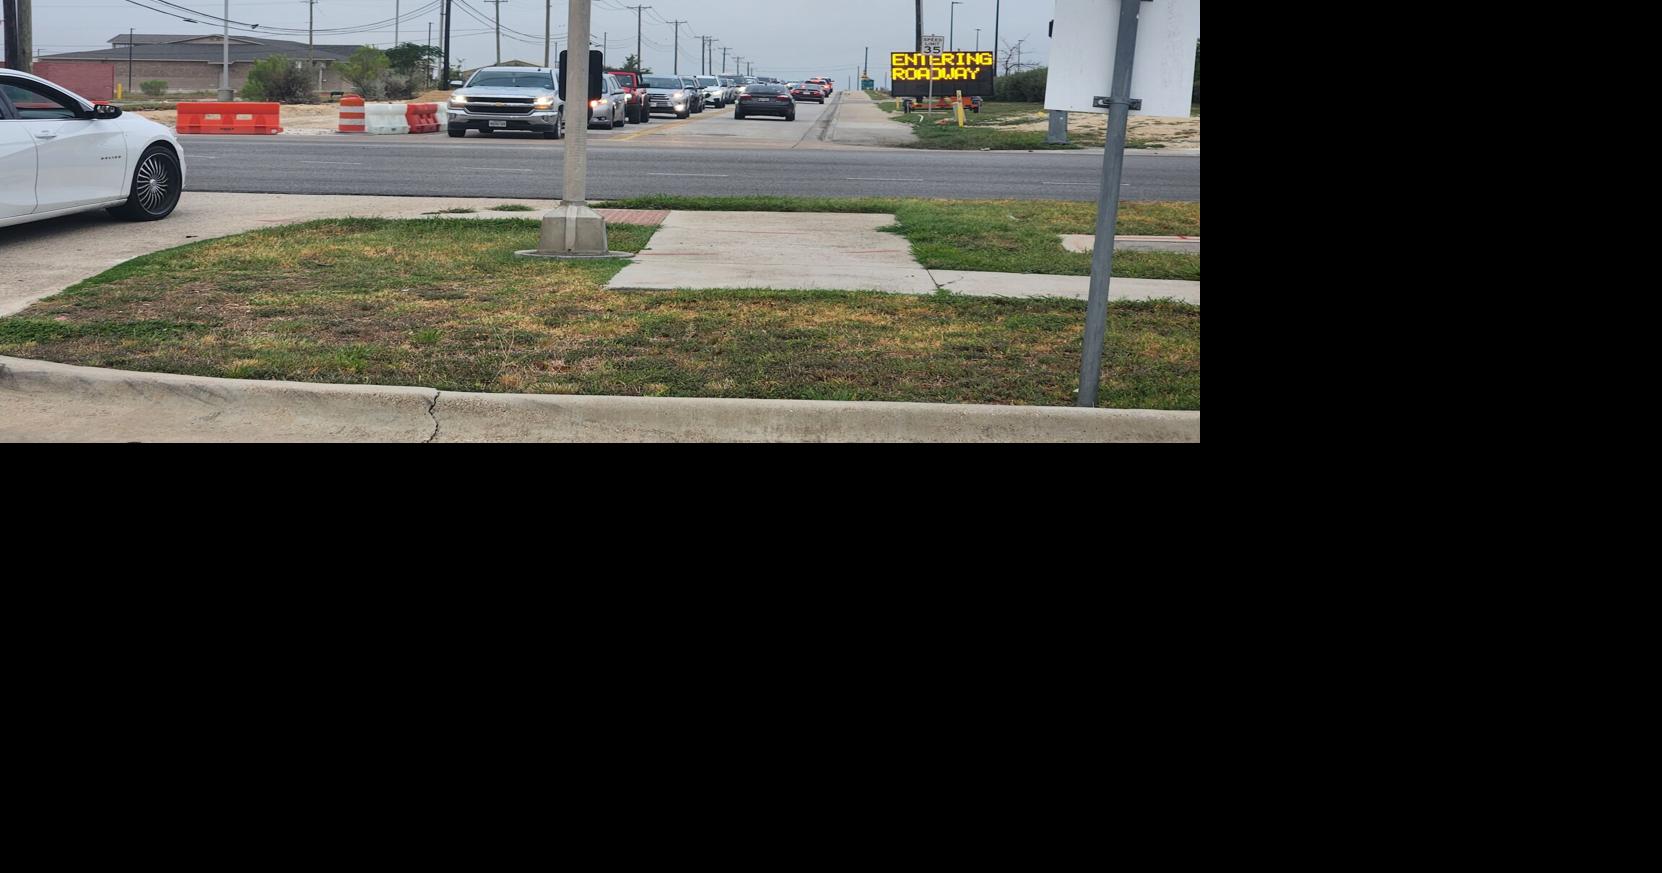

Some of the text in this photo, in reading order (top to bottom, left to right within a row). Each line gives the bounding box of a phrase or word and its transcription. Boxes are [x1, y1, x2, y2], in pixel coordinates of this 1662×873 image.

[924, 46, 941, 54] 35
[892, 53, 993, 66] ENTERING
[892, 67, 980, 80] ROADWAY
